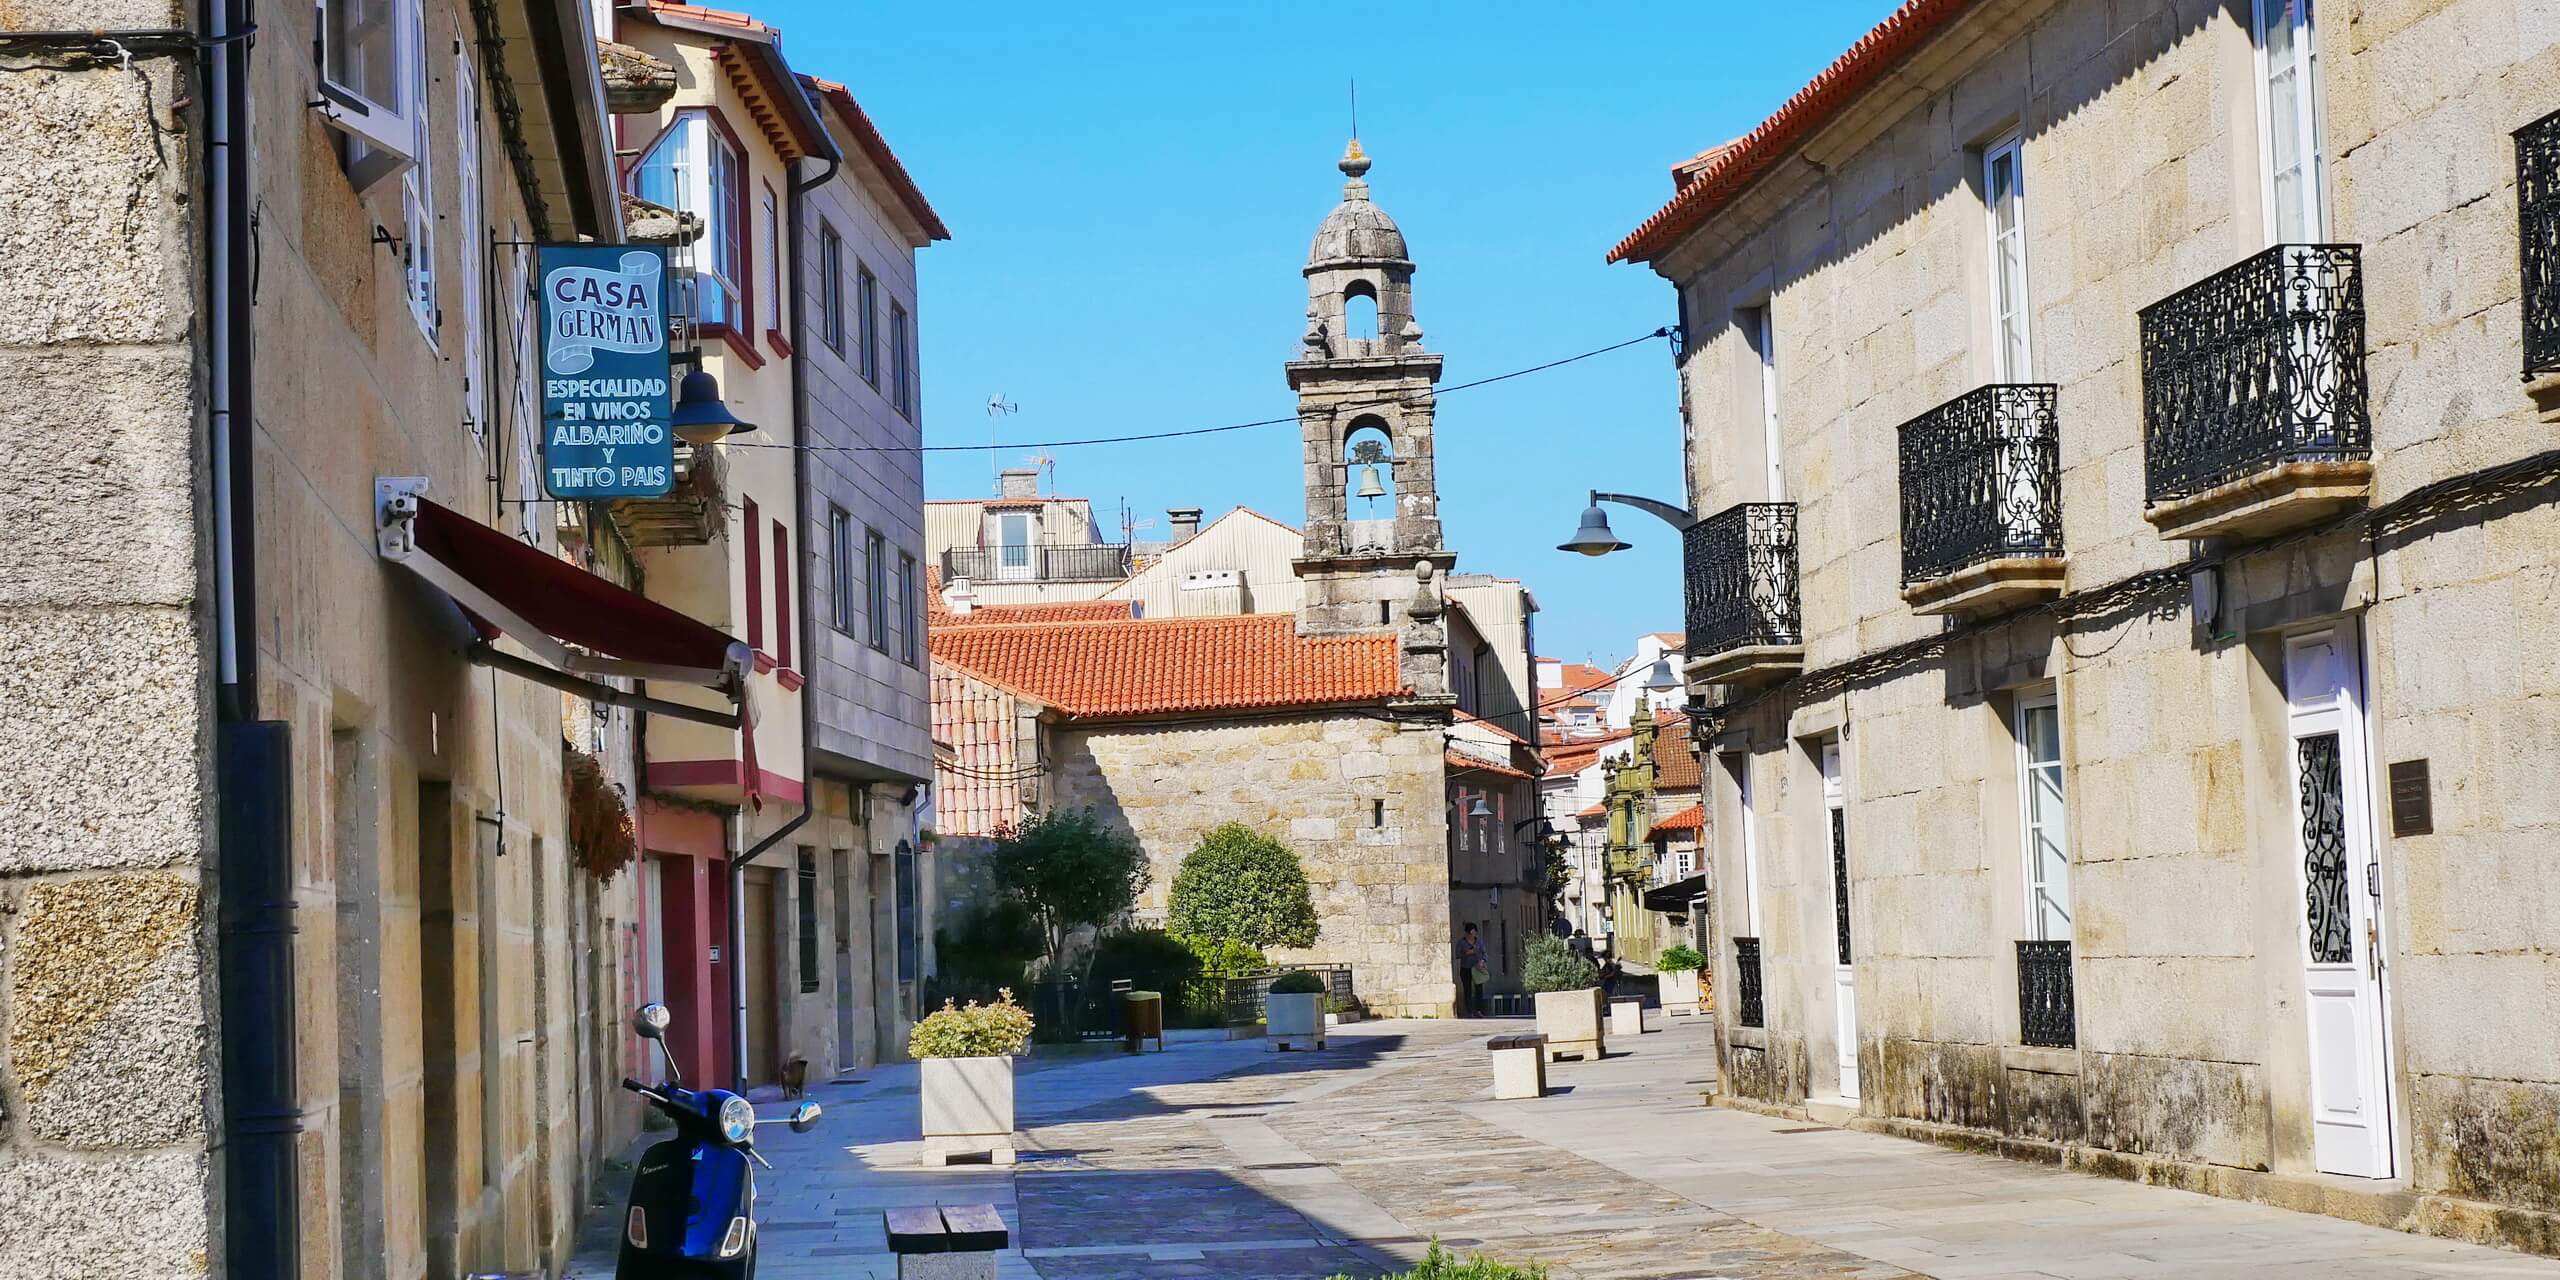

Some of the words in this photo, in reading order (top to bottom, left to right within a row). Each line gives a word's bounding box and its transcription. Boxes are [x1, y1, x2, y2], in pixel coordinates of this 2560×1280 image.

[555, 277, 649, 309] CASA
[558, 309, 655, 345] GERMAN
[547, 379, 666, 398] ESPECIALIDAD
[563, 402, 586, 420] EN
[592, 401, 651, 419] VINOS
[553, 422, 663, 446] ALBARIÑO
[603, 448, 614, 463] Y
[552, 467, 616, 487] TINTO
[621, 466, 666, 486] PAIS
